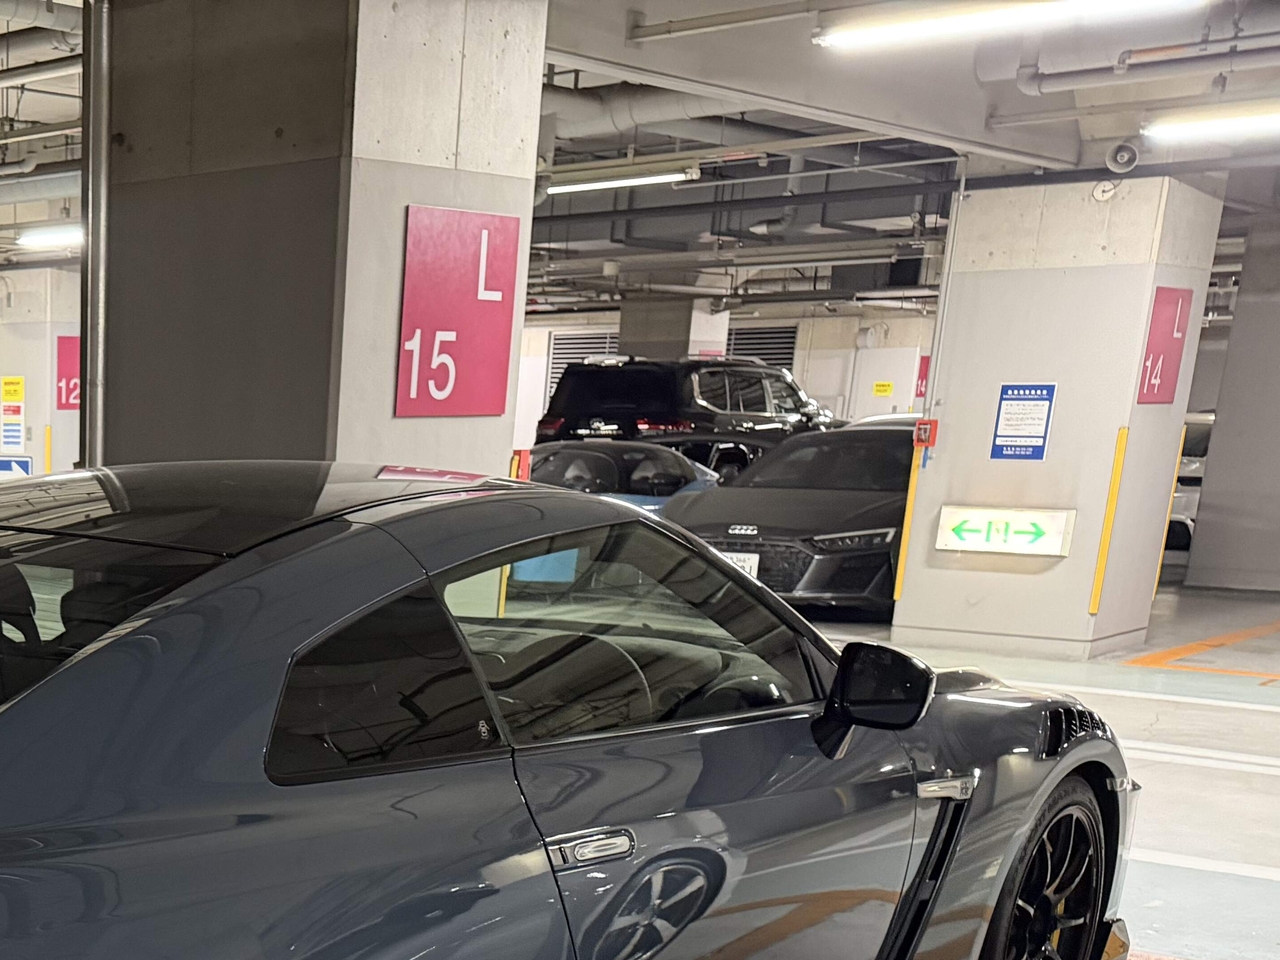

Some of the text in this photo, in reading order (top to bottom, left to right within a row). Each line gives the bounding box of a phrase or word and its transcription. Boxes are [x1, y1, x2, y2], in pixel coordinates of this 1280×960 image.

[477, 229, 503, 302] L
[1173, 297, 1182, 339] L
[404, 328, 457, 400] 15
[1144, 353, 1164, 394] 14
[57, 377, 80, 404] 12
